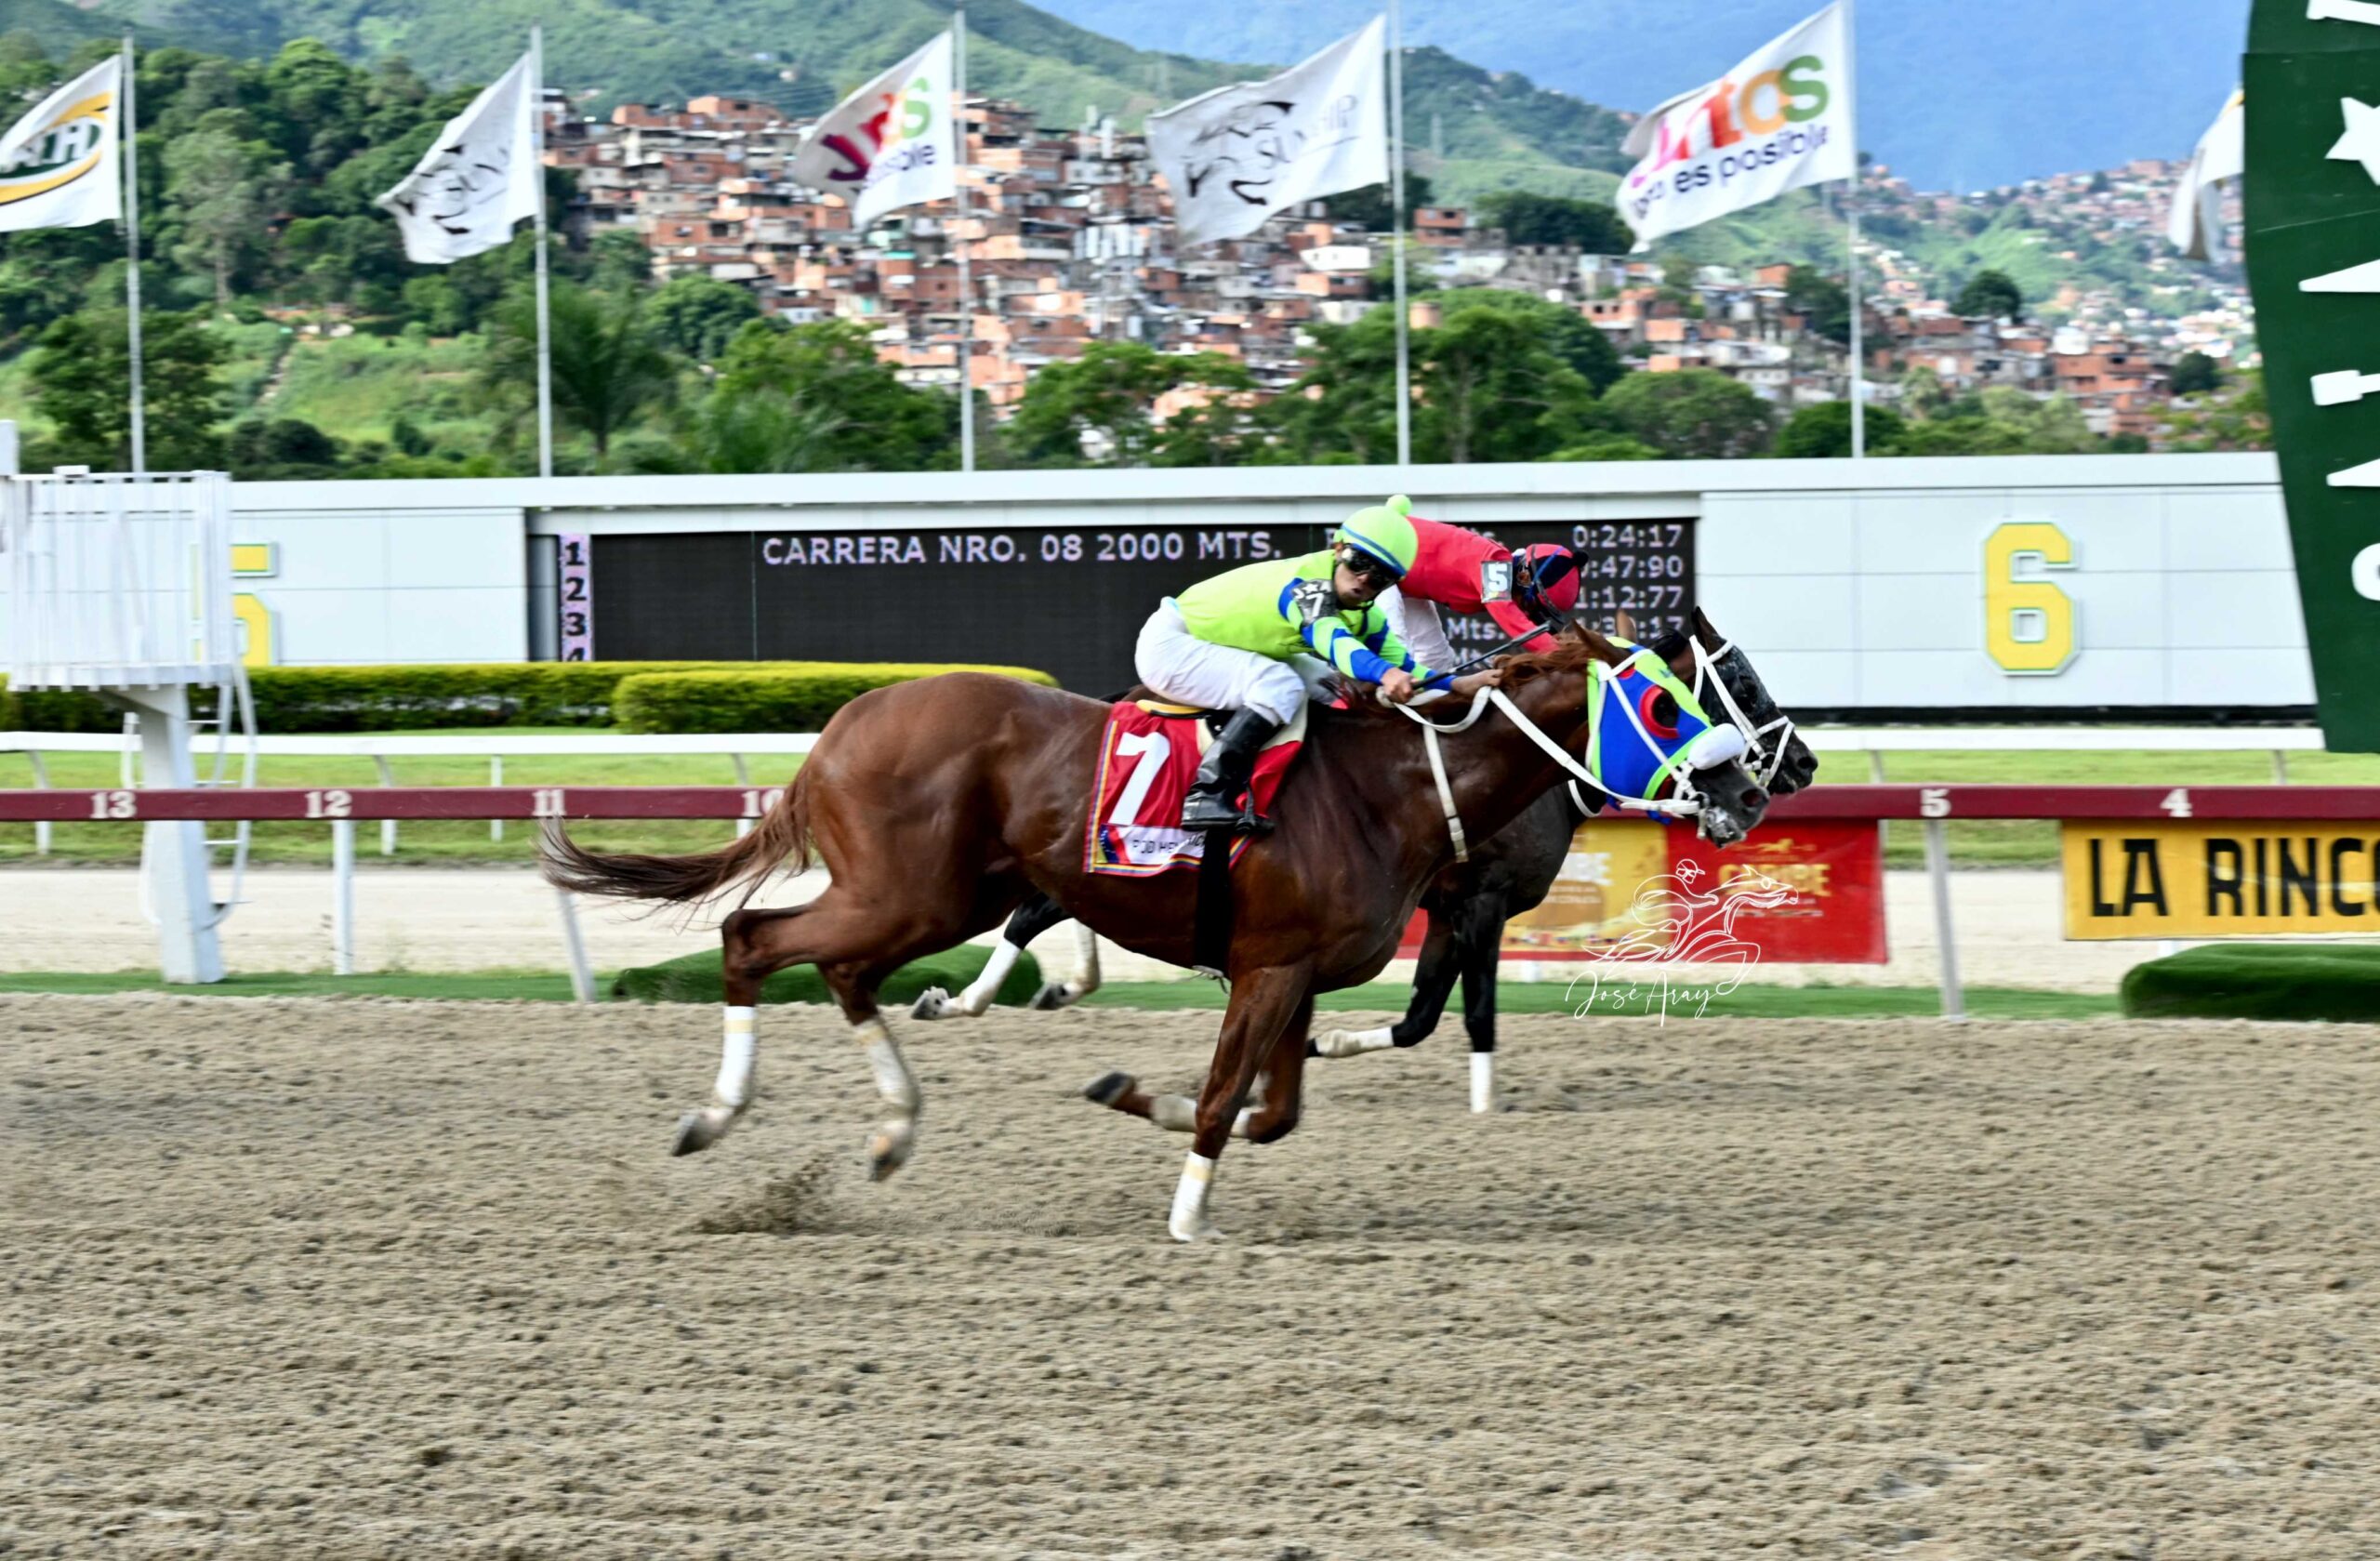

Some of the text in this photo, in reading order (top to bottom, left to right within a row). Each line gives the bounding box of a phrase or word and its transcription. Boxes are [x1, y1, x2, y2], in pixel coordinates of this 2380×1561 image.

[1674, 164, 1712, 192] es
[762, 531, 1282, 564] CARRERA NRO. 08 2000 MTS.
[1572, 524, 1684, 549] 0:24:17
[565, 541, 585, 566] 1
[1580, 554, 1684, 578] :47:90
[565, 576, 587, 602] 2
[1488, 563, 1509, 593] 5
[1305, 592, 1325, 617] 7
[1575, 585, 1684, 609] 1:12:77
[1983, 521, 2075, 675] 6
[565, 612, 587, 637] 3
[1446, 617, 1506, 641] Mts.
[1575, 615, 1684, 640] 1:3:17
[1107, 731, 1171, 826] 7
[90, 789, 137, 819] 13
[304, 789, 352, 818] 12
[532, 789, 566, 817] 11
[1921, 788, 1950, 817] 5
[2160, 788, 2192, 817] 4
[2086, 838, 2380, 918] LA RINC
